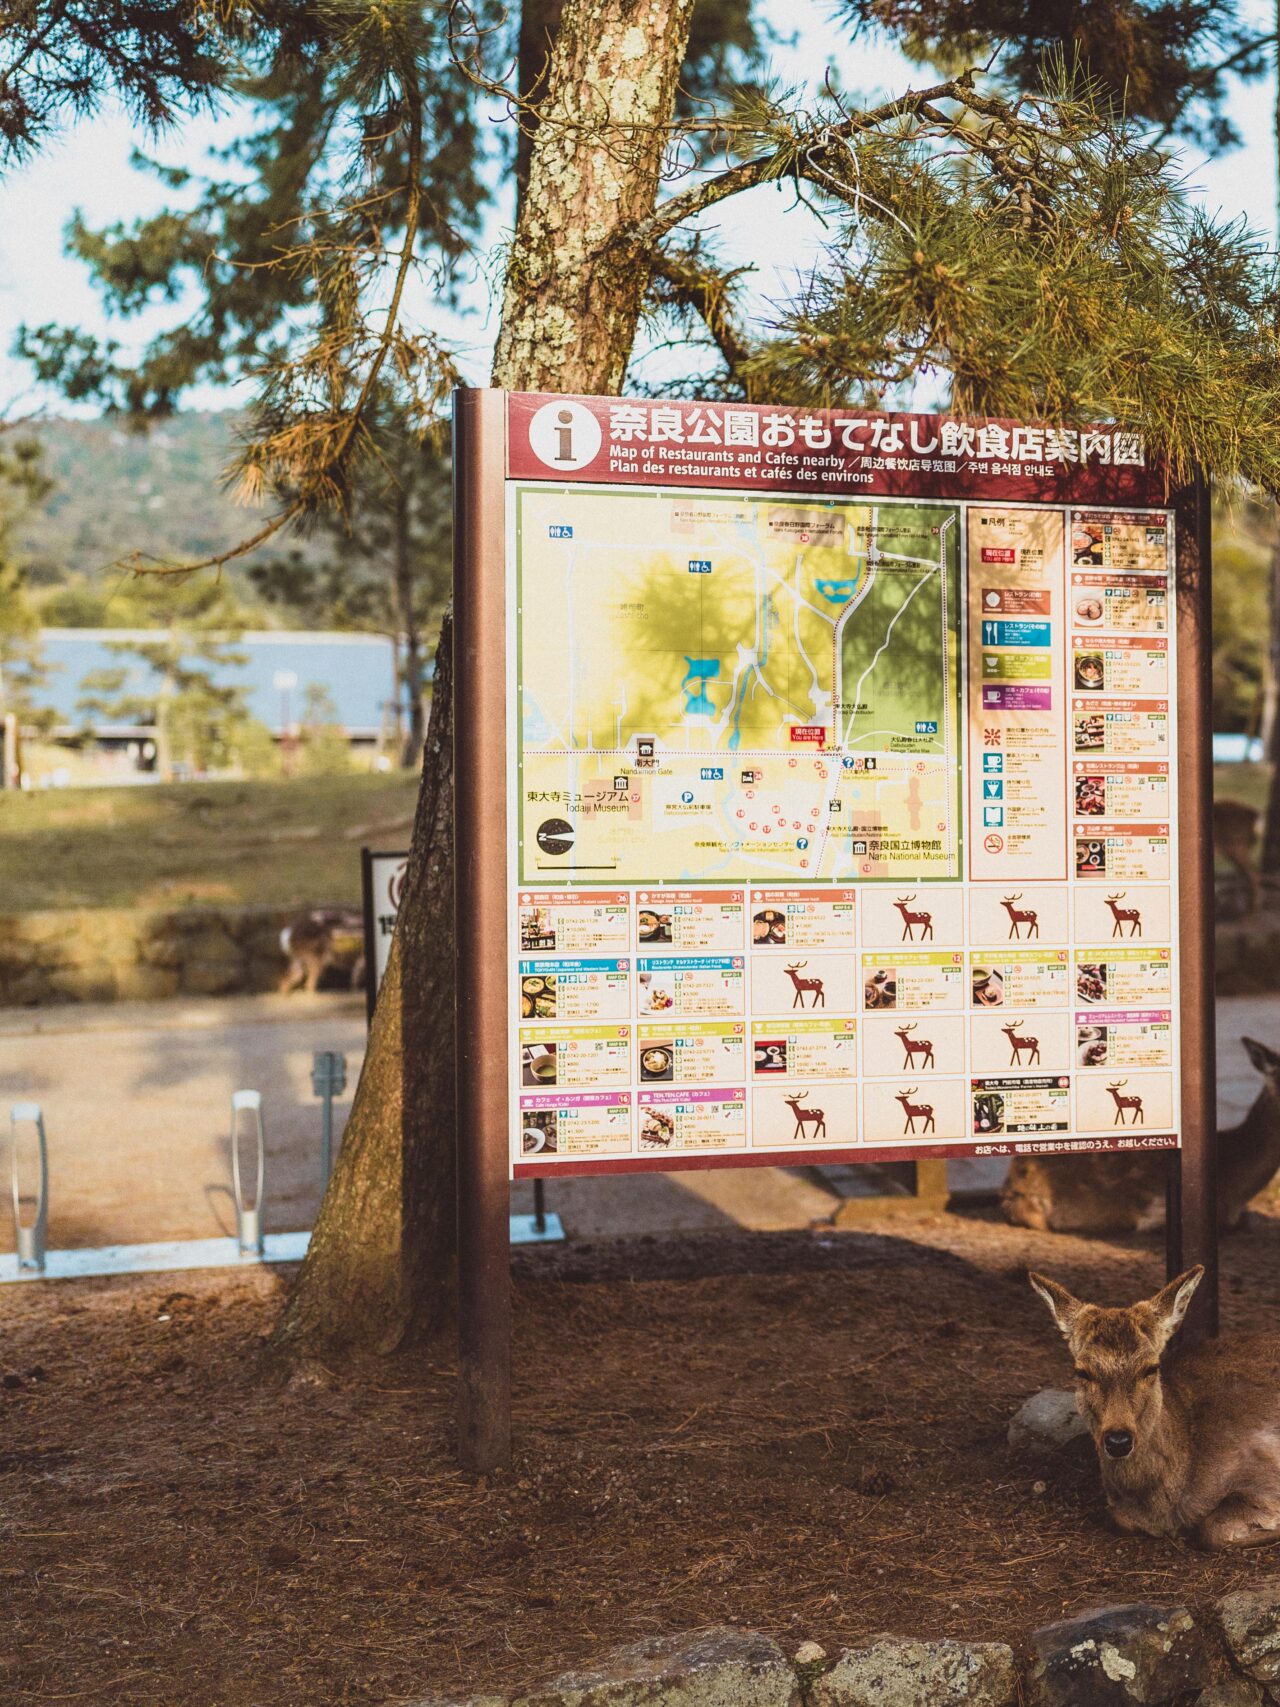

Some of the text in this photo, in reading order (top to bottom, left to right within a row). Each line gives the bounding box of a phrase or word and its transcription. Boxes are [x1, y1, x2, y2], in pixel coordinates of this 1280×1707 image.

[609, 446, 636, 460] Map
[641, 446, 654, 458] of
[659, 447, 734, 463] Restaurants
[738, 450, 761, 463] and
[765, 451, 799, 465] Cafes
[803, 454, 845, 468] nearby
[991, 463, 1021, 475] 음식점
[609, 460, 874, 484] Plan des restaurants et cafés des environs
[527, 792, 629, 802] 東大寺ミュージアム
[565, 804, 630, 814] Todaiji Museum
[869, 840, 941, 851] 奈良国立博物館
[923, 853, 955, 861] Museum
